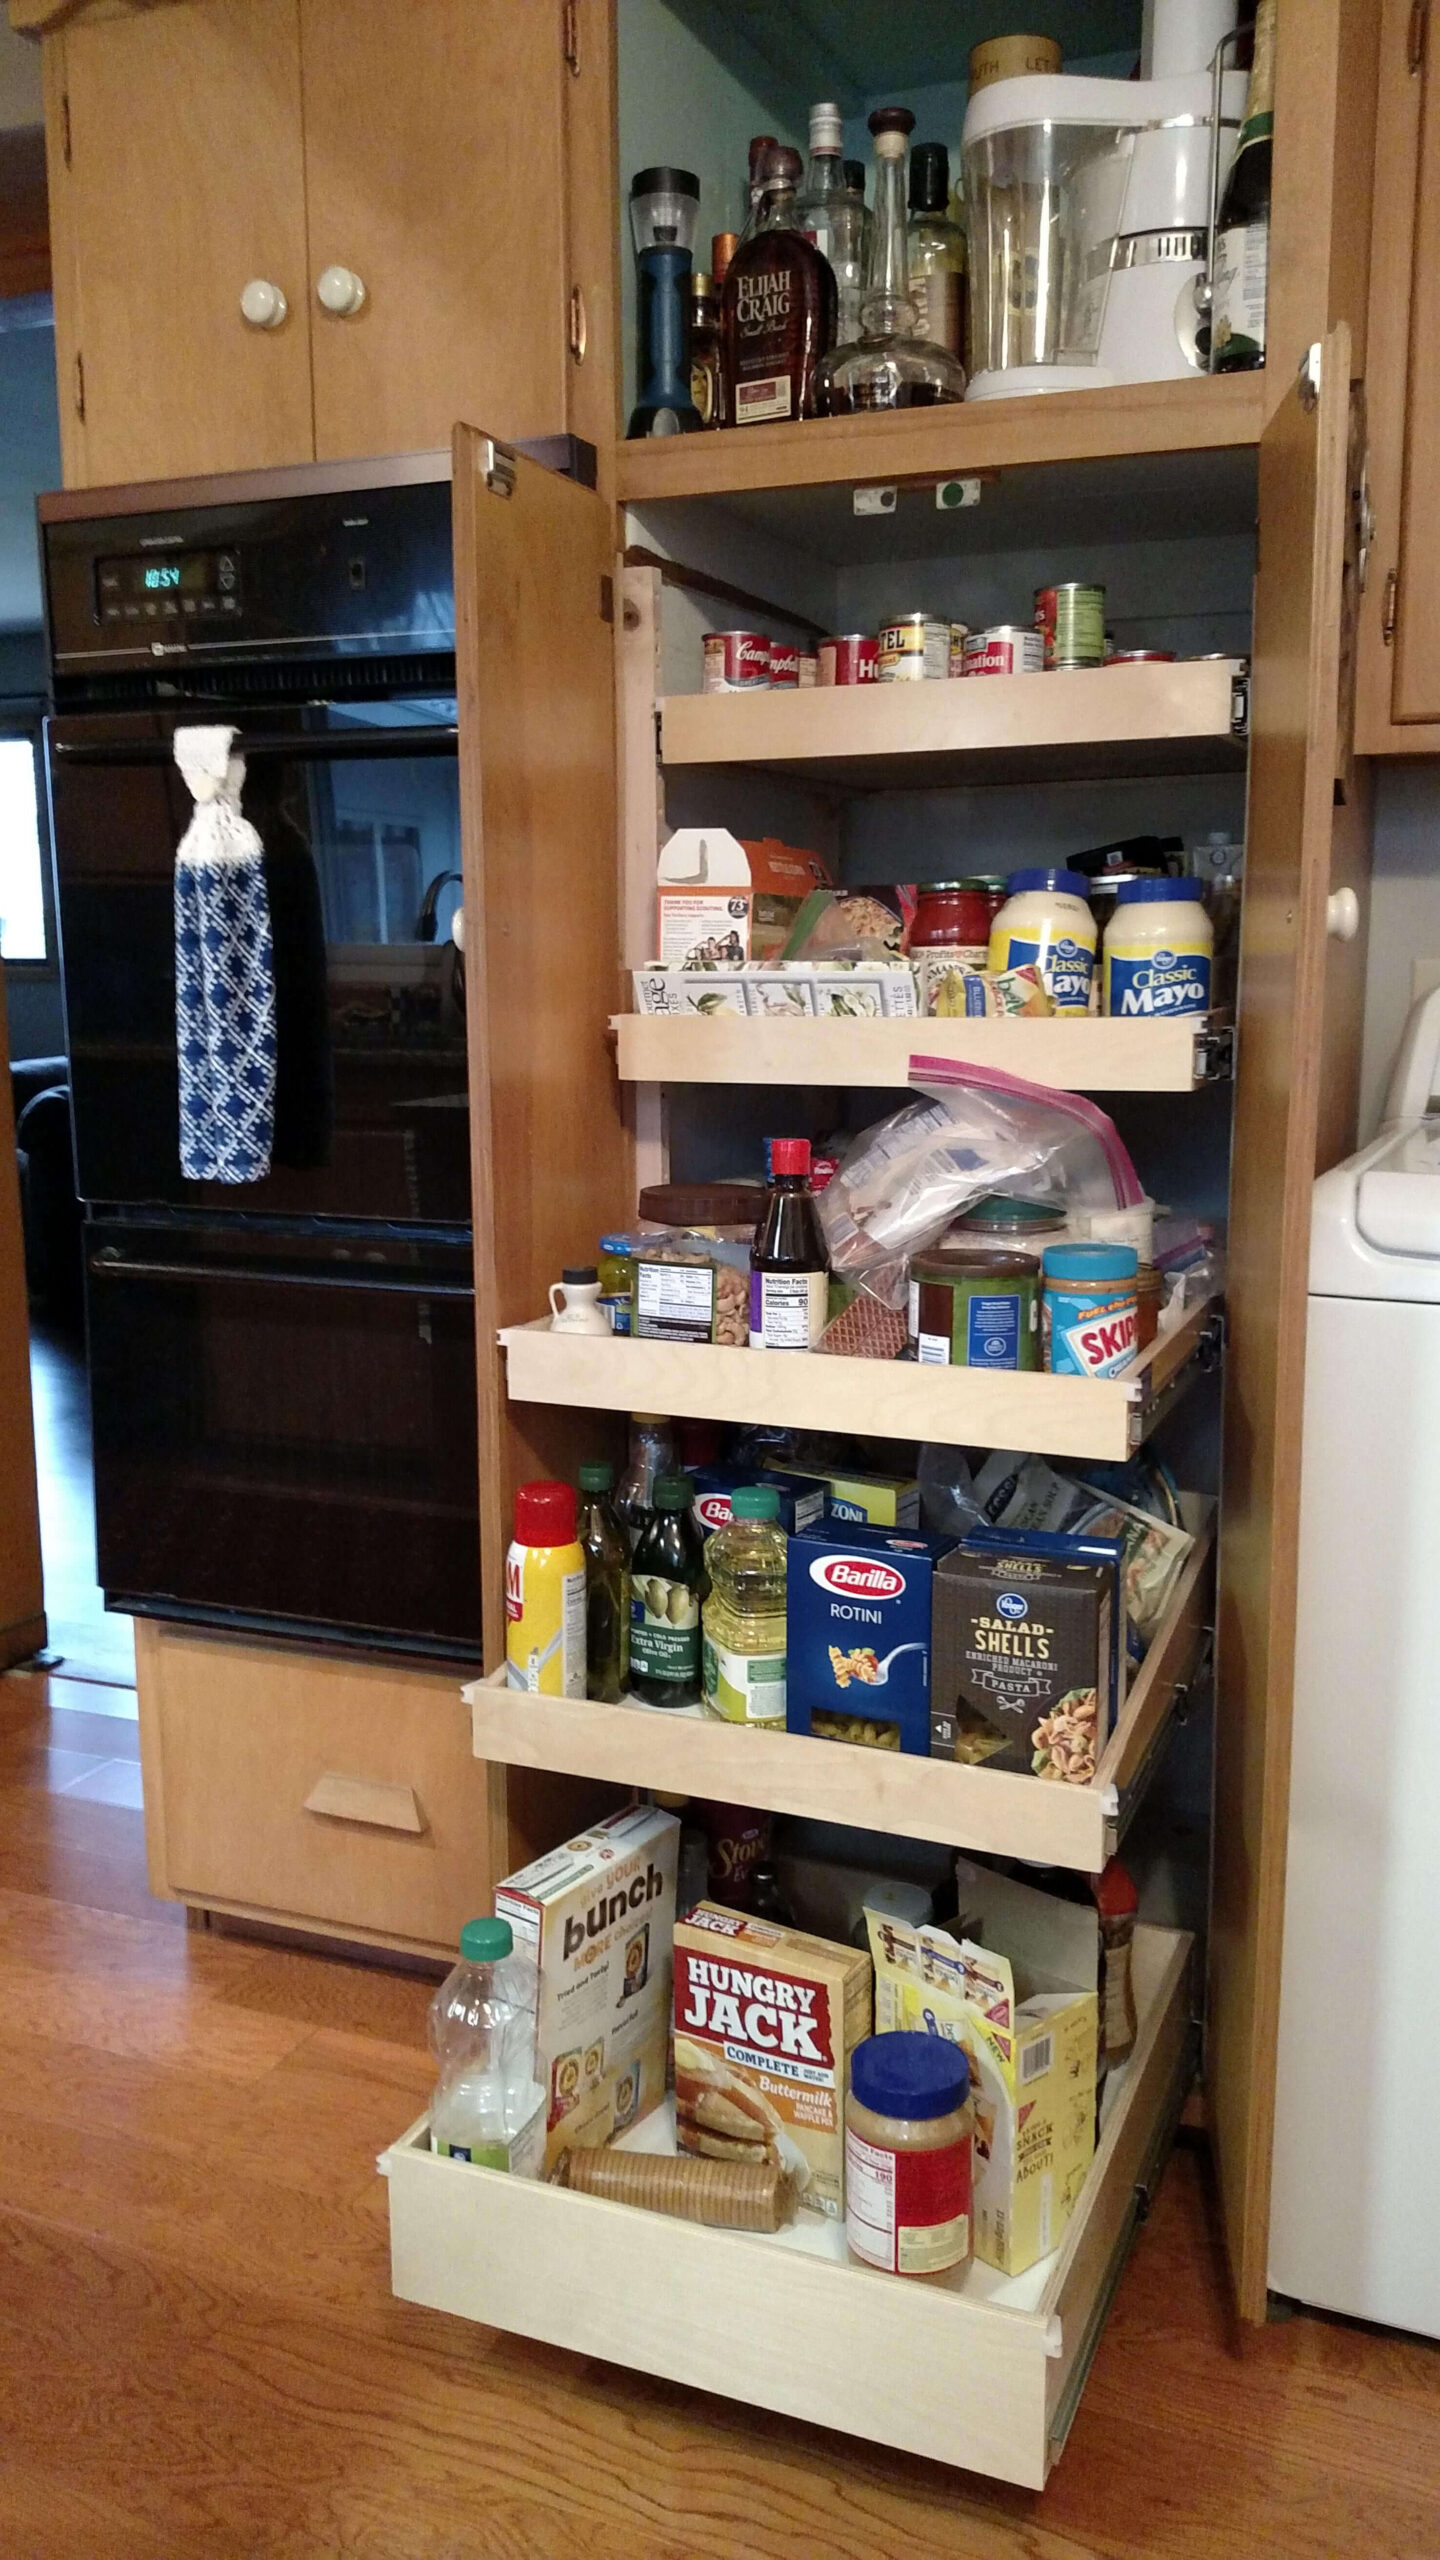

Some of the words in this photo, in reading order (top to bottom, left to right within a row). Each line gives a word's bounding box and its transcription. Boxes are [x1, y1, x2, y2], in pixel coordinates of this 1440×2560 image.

[737, 270, 791, 299] ELIJAH
[737, 293, 790, 322] CRAIG
[1132, 964, 1197, 989] Classic
[1121, 983, 1204, 1015] Mayo
[798, 1298, 809, 1306] 90
[831, 1564, 898, 1591] Barilla
[997, 1561, 1042, 1573] SHELLS
[830, 1603, 882, 1624] ROTINI
[631, 1635, 653, 1649] Extra
[654, 1639, 683, 1653] Virgin
[642, 1648, 658, 1657] Olive
[975, 1630, 1050, 1659] SHELLS
[965, 1650, 1010, 1665] ENRICHED
[1012, 1657, 1059, 1671] MACARONI
[992, 1663, 1032, 1676] PRODUCT
[991, 1679, 1031, 1693] PASTA
[563, 1863, 663, 1961] bunch
[696, 1909, 744, 1927] HUNGRY
[685, 1915, 738, 1936] JACK
[687, 1956, 815, 2014] HUNGRY
[684, 1984, 823, 2062] JACK
[726, 2046, 800, 2078] COMPLETE
[759, 2075, 832, 2108] Buttermilk
[793, 2109, 822, 2125] WAFFLE
[821, 2116, 834, 2127] MIX
[795, 2102, 828, 2117] PANCAKE
[875, 2171, 892, 2181] 190
